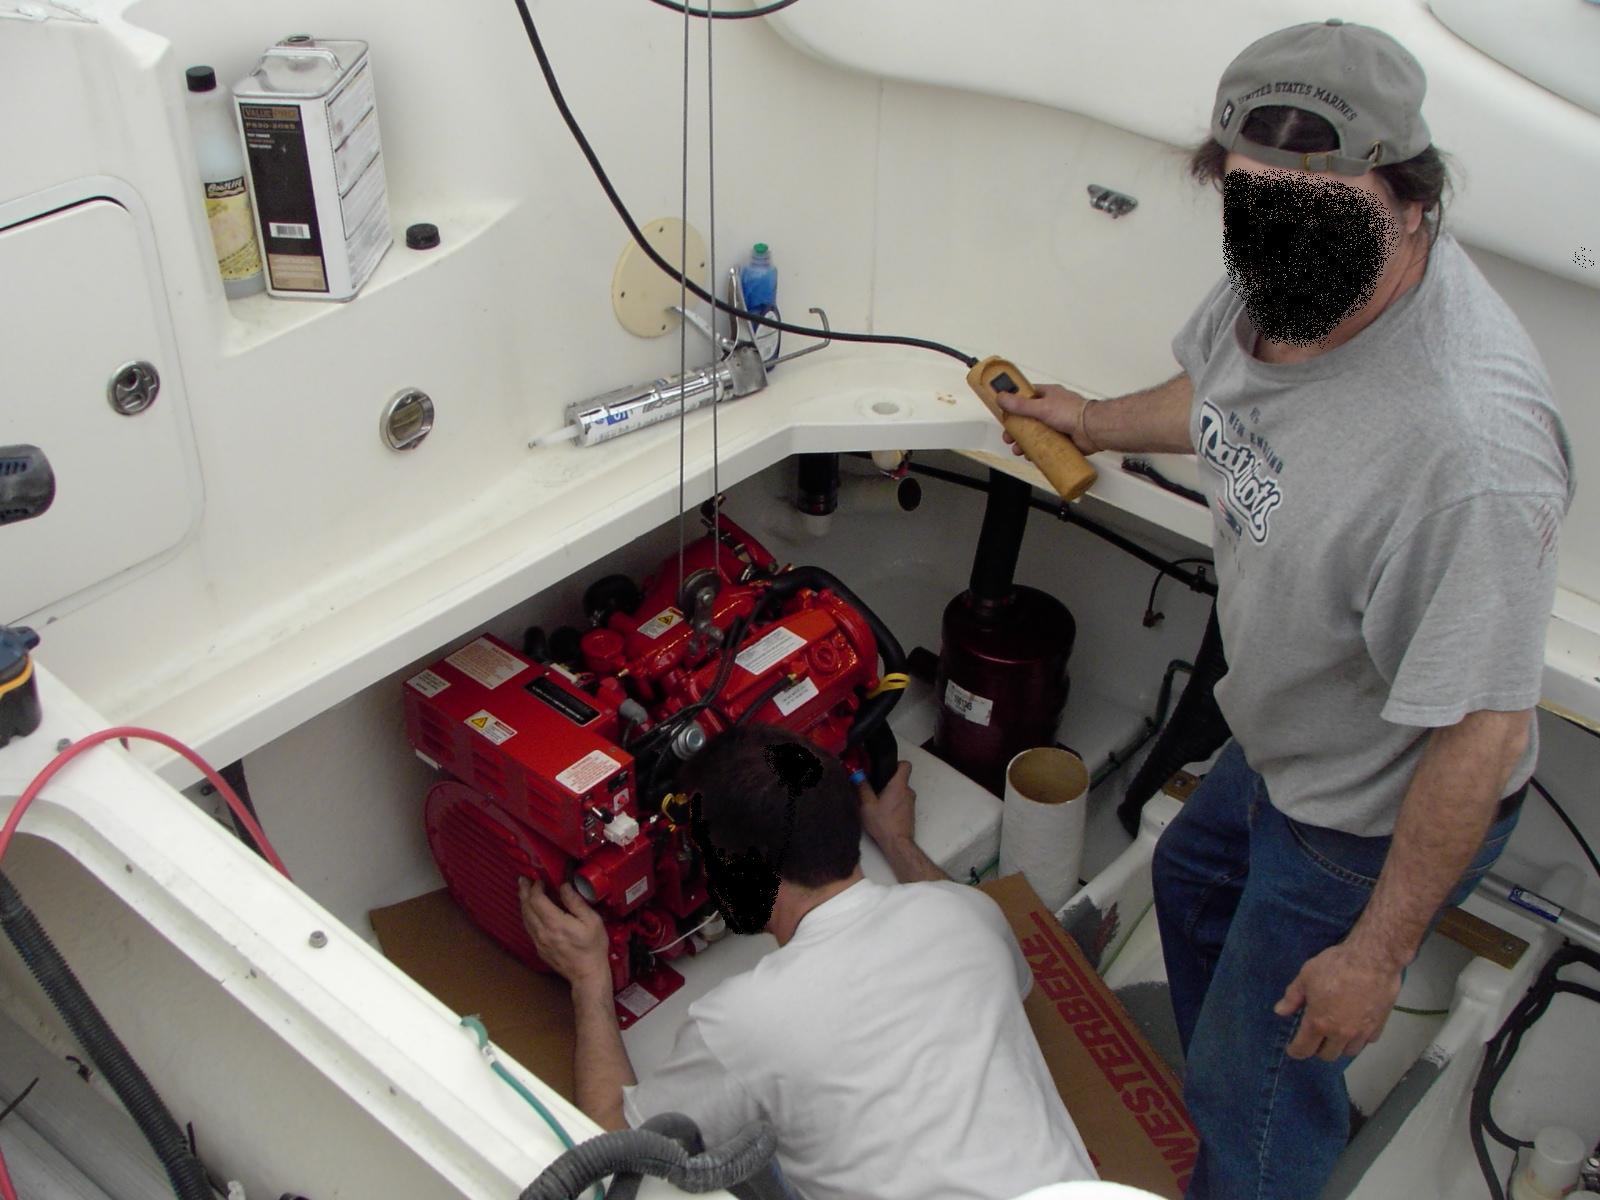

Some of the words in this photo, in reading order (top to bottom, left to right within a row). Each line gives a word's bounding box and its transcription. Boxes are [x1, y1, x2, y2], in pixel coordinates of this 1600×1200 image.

[1238, 83, 1272, 104] UNITED
[1275, 81, 1312, 95] STATES
[1313, 87, 1359, 122] MARINES
[1022, 932, 1197, 1174] WESTERBEKE
